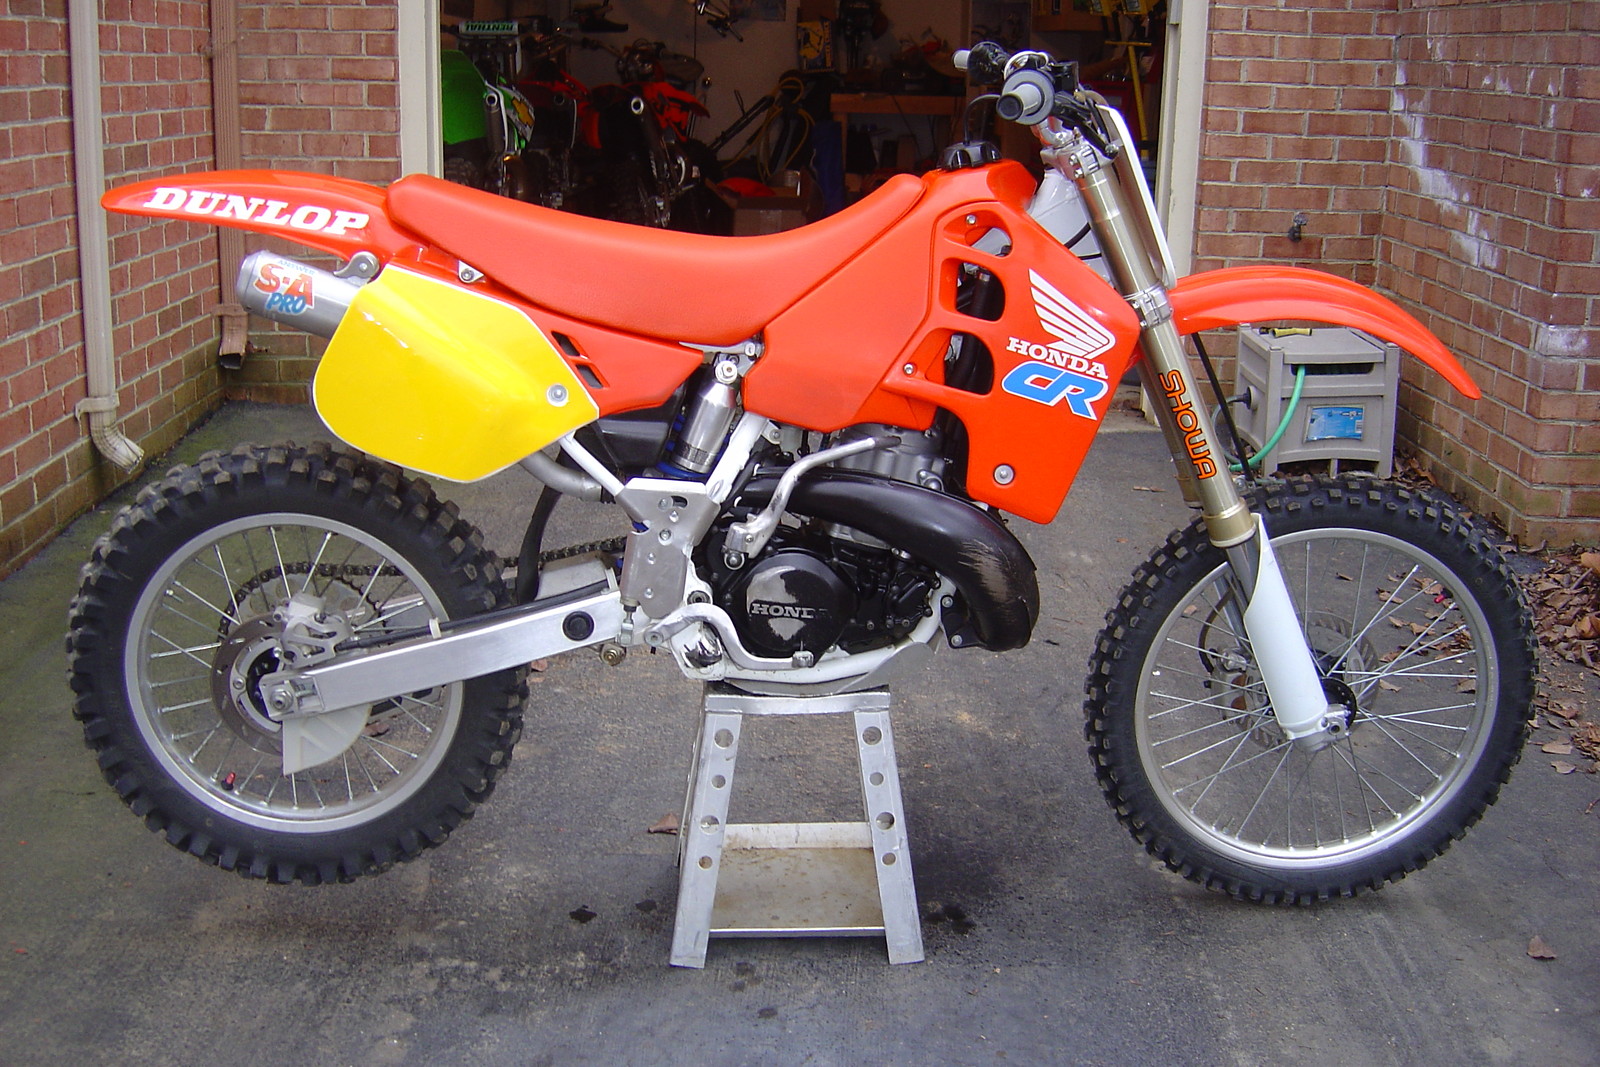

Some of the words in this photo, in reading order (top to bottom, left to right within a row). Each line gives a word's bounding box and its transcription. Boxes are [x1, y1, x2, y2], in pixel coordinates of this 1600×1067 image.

[143, 187, 370, 235] DUNLOP
[264, 291, 307, 314] PRO
[1006, 336, 1109, 379] HONDA
[1001, 360, 1109, 420] CR
[1159, 369, 1218, 480] SHOWA
